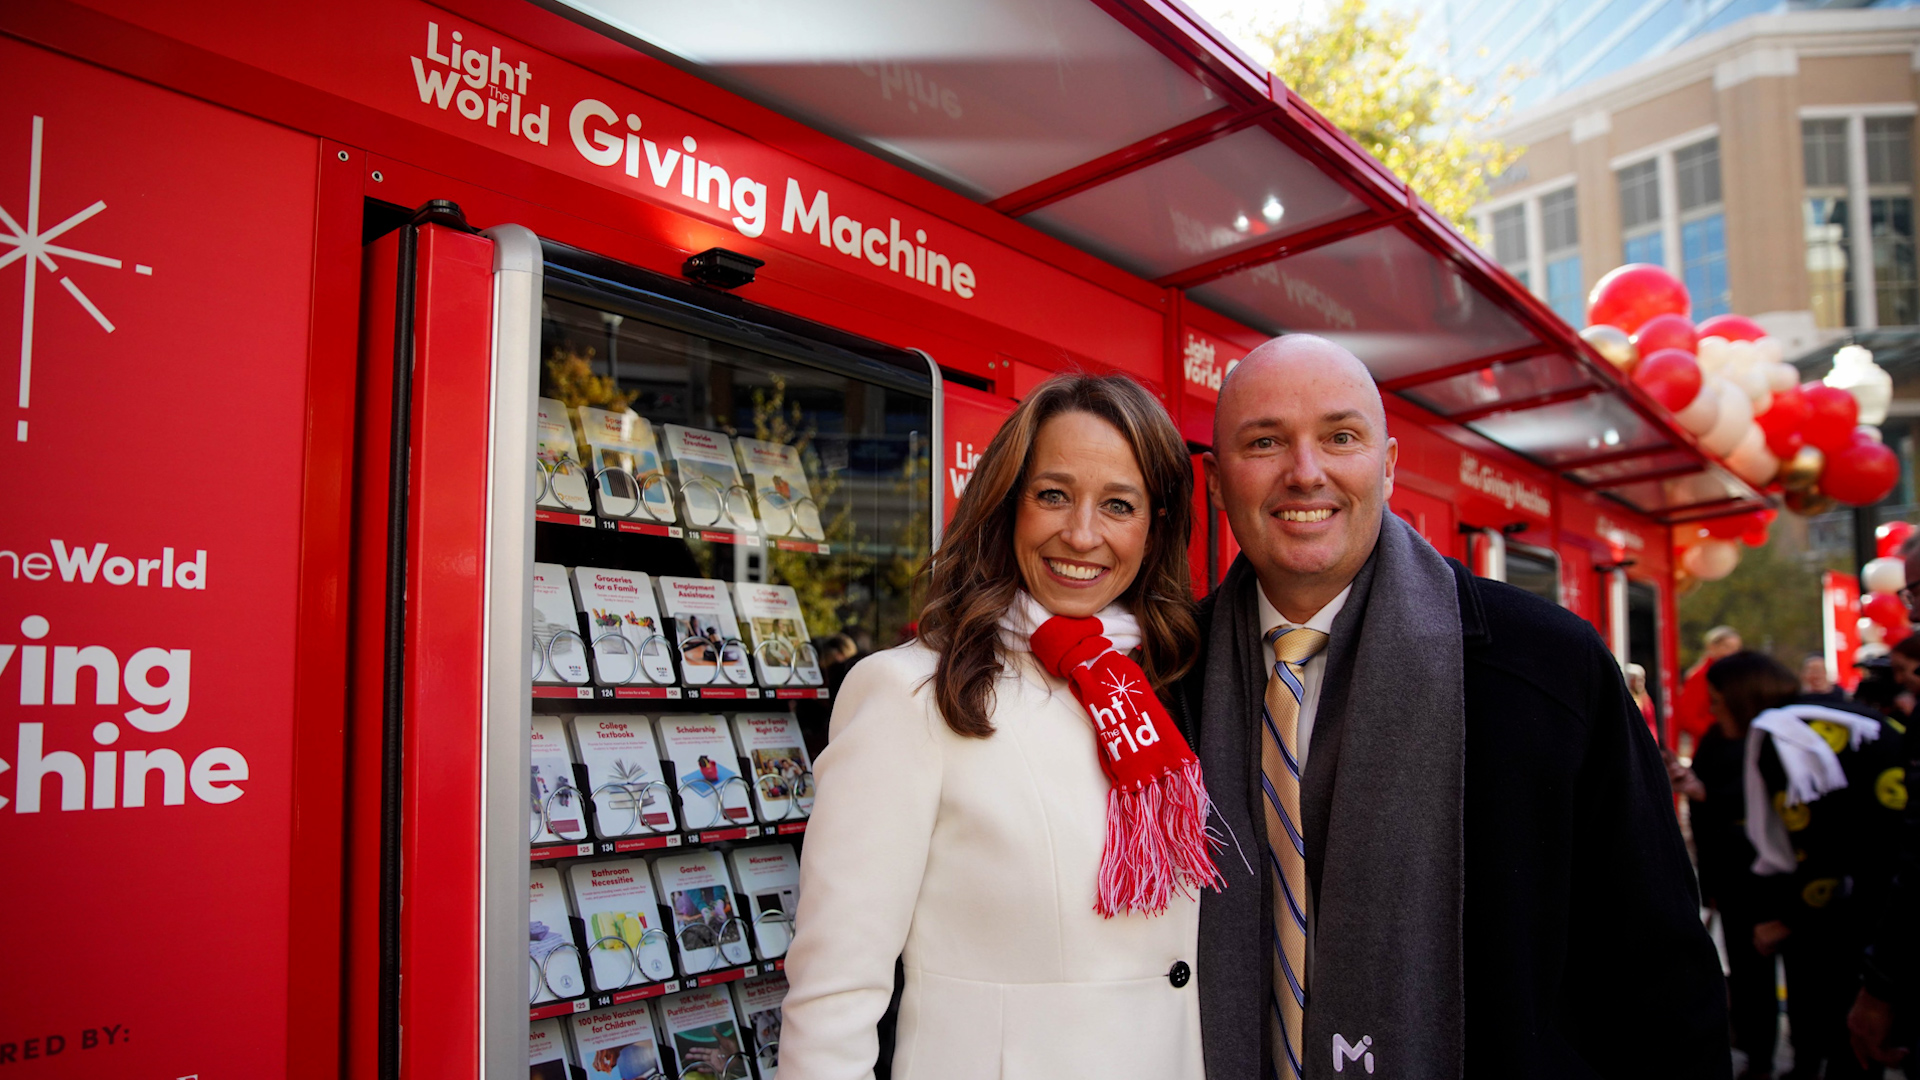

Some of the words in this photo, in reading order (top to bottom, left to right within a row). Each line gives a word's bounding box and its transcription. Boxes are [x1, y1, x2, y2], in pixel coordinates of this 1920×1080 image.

[427, 21, 532, 95] Light
[488, 83, 510, 103] The
[410, 56, 549, 146] World
[569, 99, 767, 238] Giving
[781, 177, 976, 299] Machine
[684, 431, 712, 443] Fluoride
[683, 439, 718, 450] Treatment
[603, 521, 615, 530] 114
[596, 574, 633, 584] Groceries
[594, 582, 606, 591] for
[614, 584, 638, 594] Family
[673, 582, 715, 592] Employment
[678, 591, 715, 599] Assistance
[601, 689, 613, 698] 124
[1089, 696, 1127, 731] ht
[599, 722, 628, 731] College
[767, 718, 788, 726] Family
[596, 730, 635, 739] Textbooks
[676, 726, 716, 734] Scholarship
[755, 726, 772, 735] Night
[773, 725, 785, 733] Out
[1100, 728, 1120, 741] The
[1107, 710, 1160, 762] rld
[0, 721, 249, 814] hine
[601, 843, 614, 852] 134
[749, 855, 784, 864] Microwave
[591, 866, 630, 878] Bathroom
[680, 864, 706, 874] Garden
[591, 876, 634, 888] Necessities
[598, 996, 611, 1006] 144
[693, 992, 712, 1002] Water
[667, 1003, 706, 1017] Purification
[578, 1017, 592, 1027] 100
[593, 1014, 612, 1025] Polio
[612, 1008, 645, 1019] Vaccines
[591, 1026, 604, 1034] for
[604, 1019, 637, 1031] Children
[81, 1023, 130, 1050] BY:
